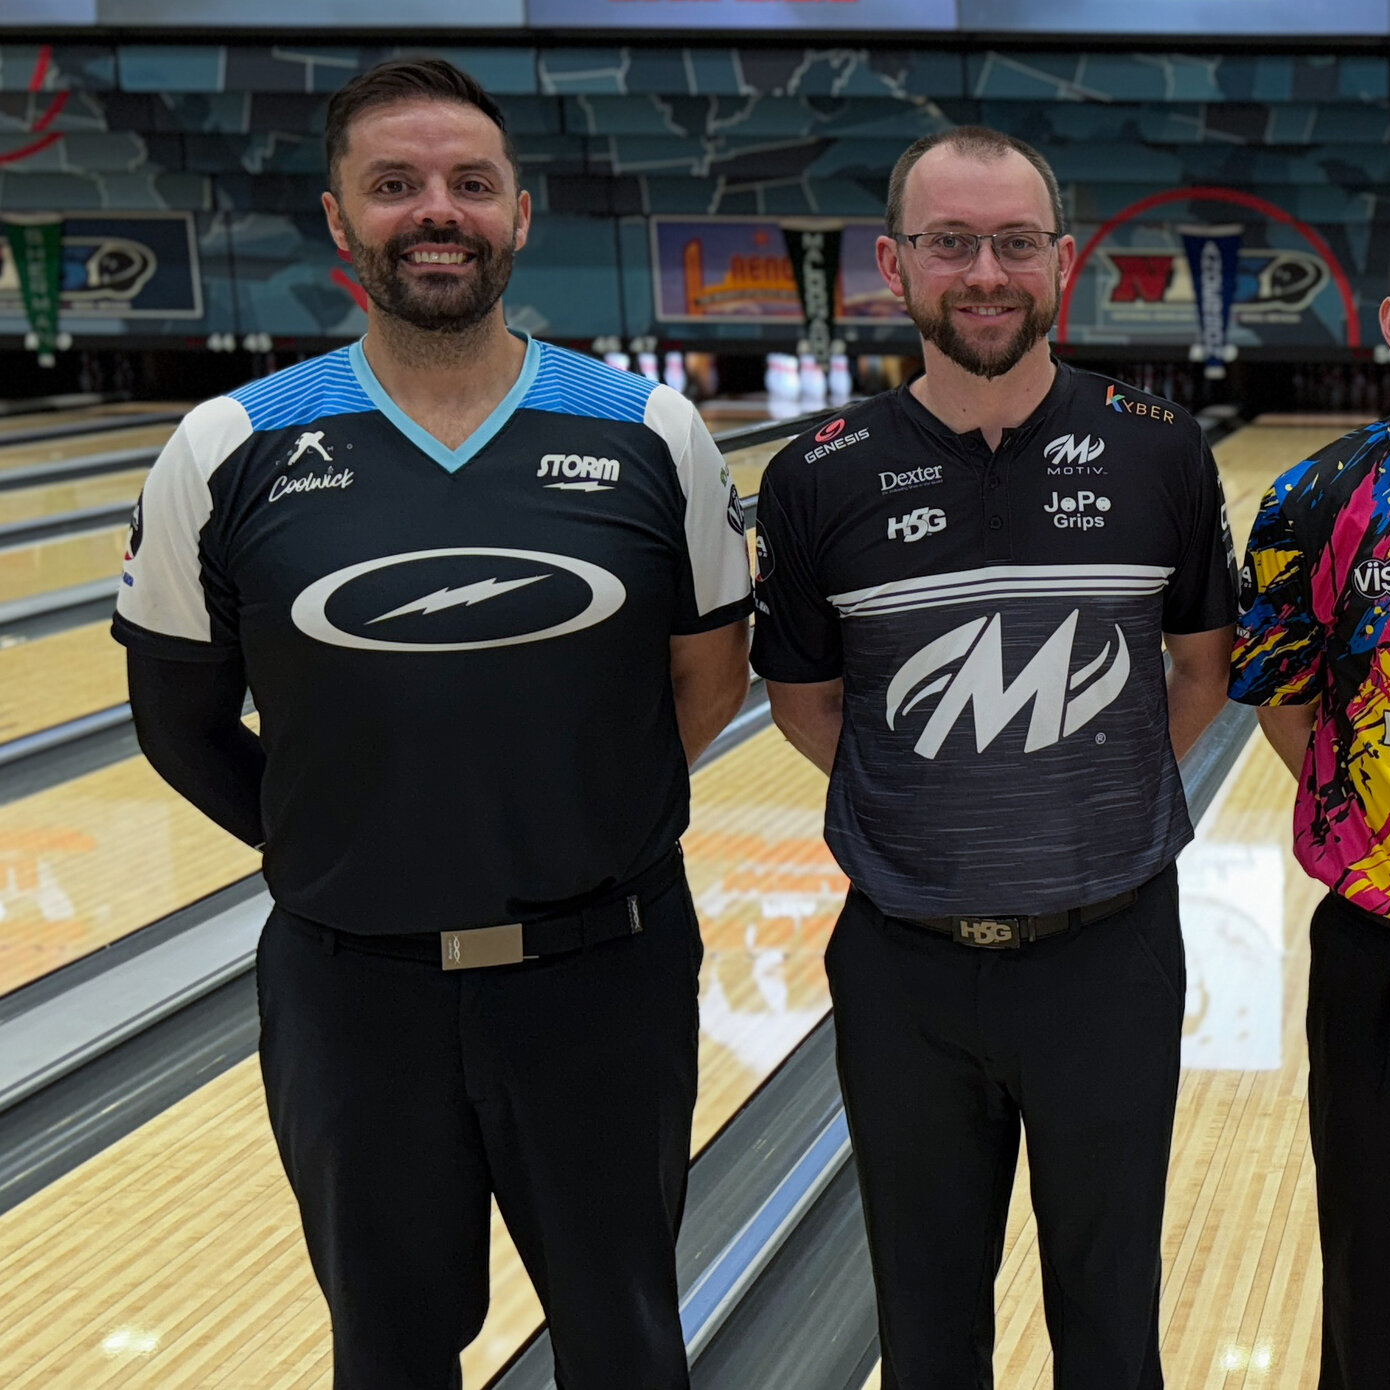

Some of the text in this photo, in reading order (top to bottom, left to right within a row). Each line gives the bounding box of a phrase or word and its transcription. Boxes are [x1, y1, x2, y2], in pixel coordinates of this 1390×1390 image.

[1105, 384, 1174, 424] KYBER
[804, 427, 870, 464] GENESIS
[536, 454, 620, 482] STORM
[878, 465, 943, 491] Dexter
[1047, 466, 1104, 475] MOTIV
[268, 468, 354, 502] Coolwick
[887, 506, 947, 543] H5G
[1053, 513, 1105, 531] Grips
[960, 920, 1012, 944] H5G
